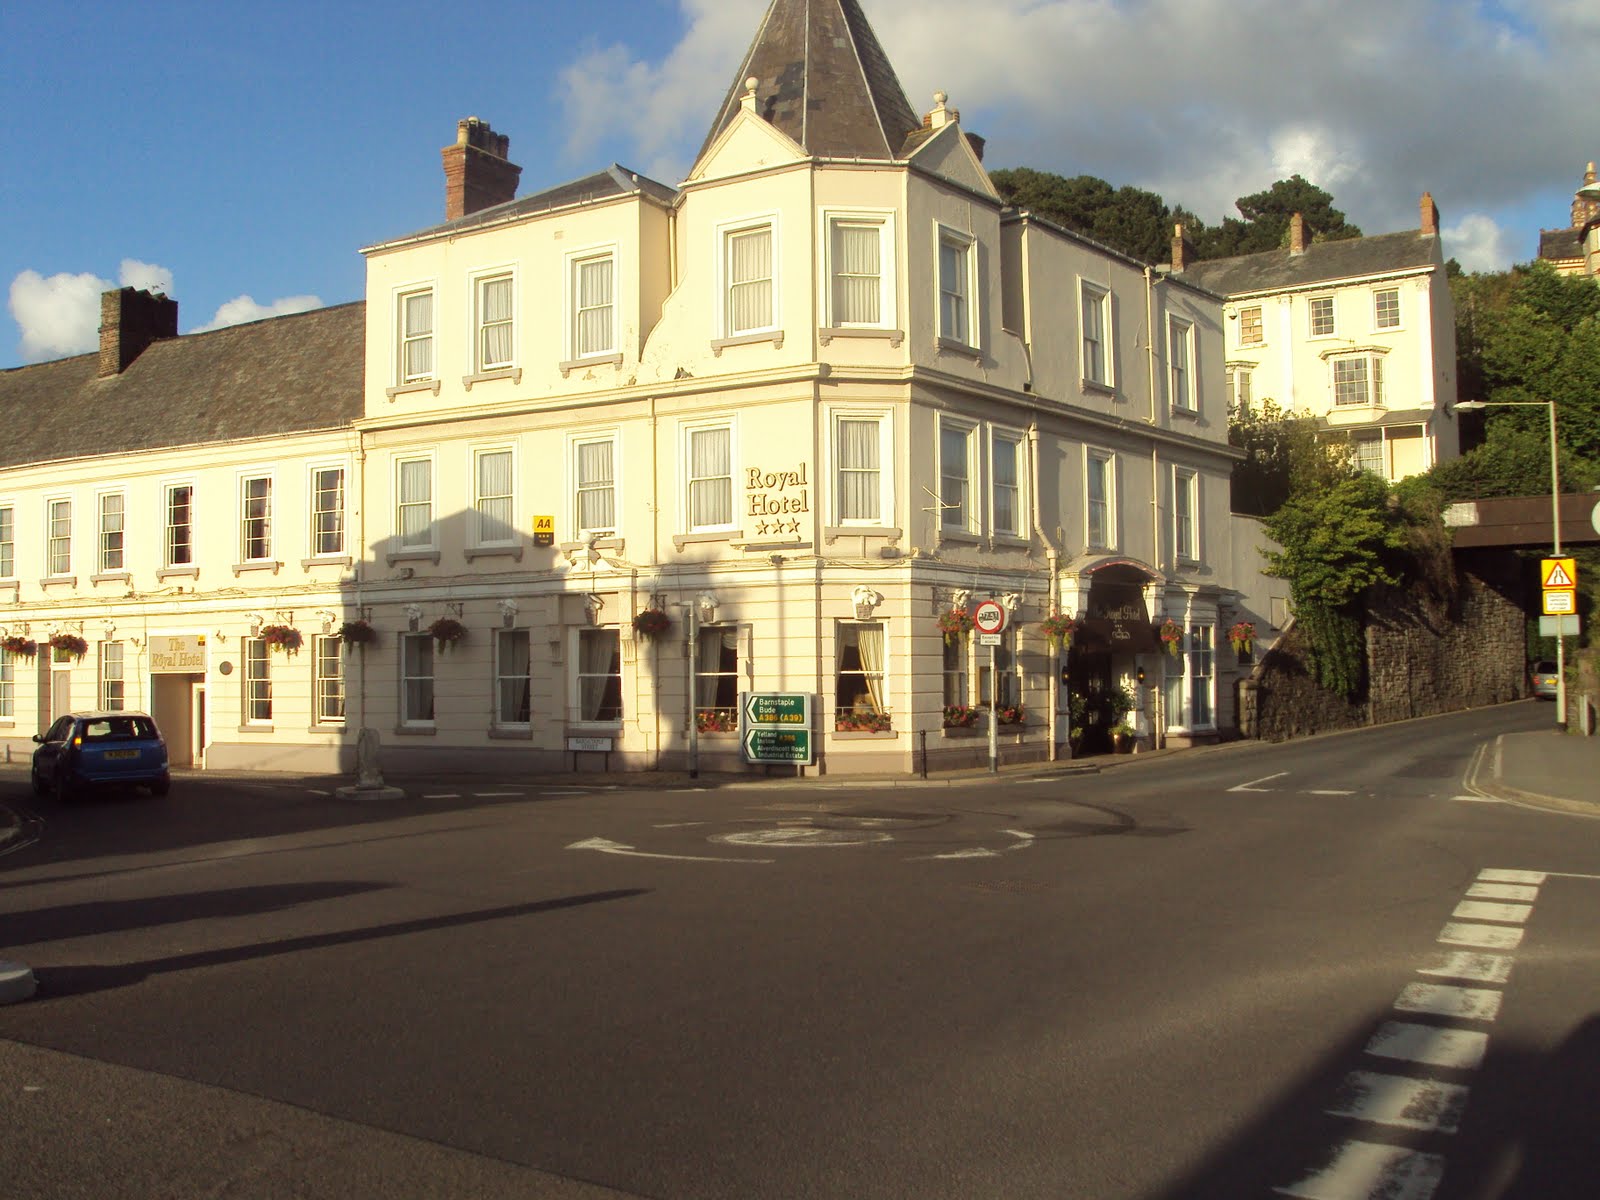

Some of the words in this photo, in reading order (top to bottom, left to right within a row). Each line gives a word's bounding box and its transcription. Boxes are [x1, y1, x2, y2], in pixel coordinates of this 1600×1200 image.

[745, 462, 808, 491] Royal
[747, 489, 809, 516] Hotel
[536, 519, 551, 529] AA
[169, 638, 185, 651] The
[152, 652, 176, 669] Royal
[178, 652, 204, 667] Hotel
[759, 698, 795, 706] Barnstaple
[780, 713, 803, 722] (A39)
